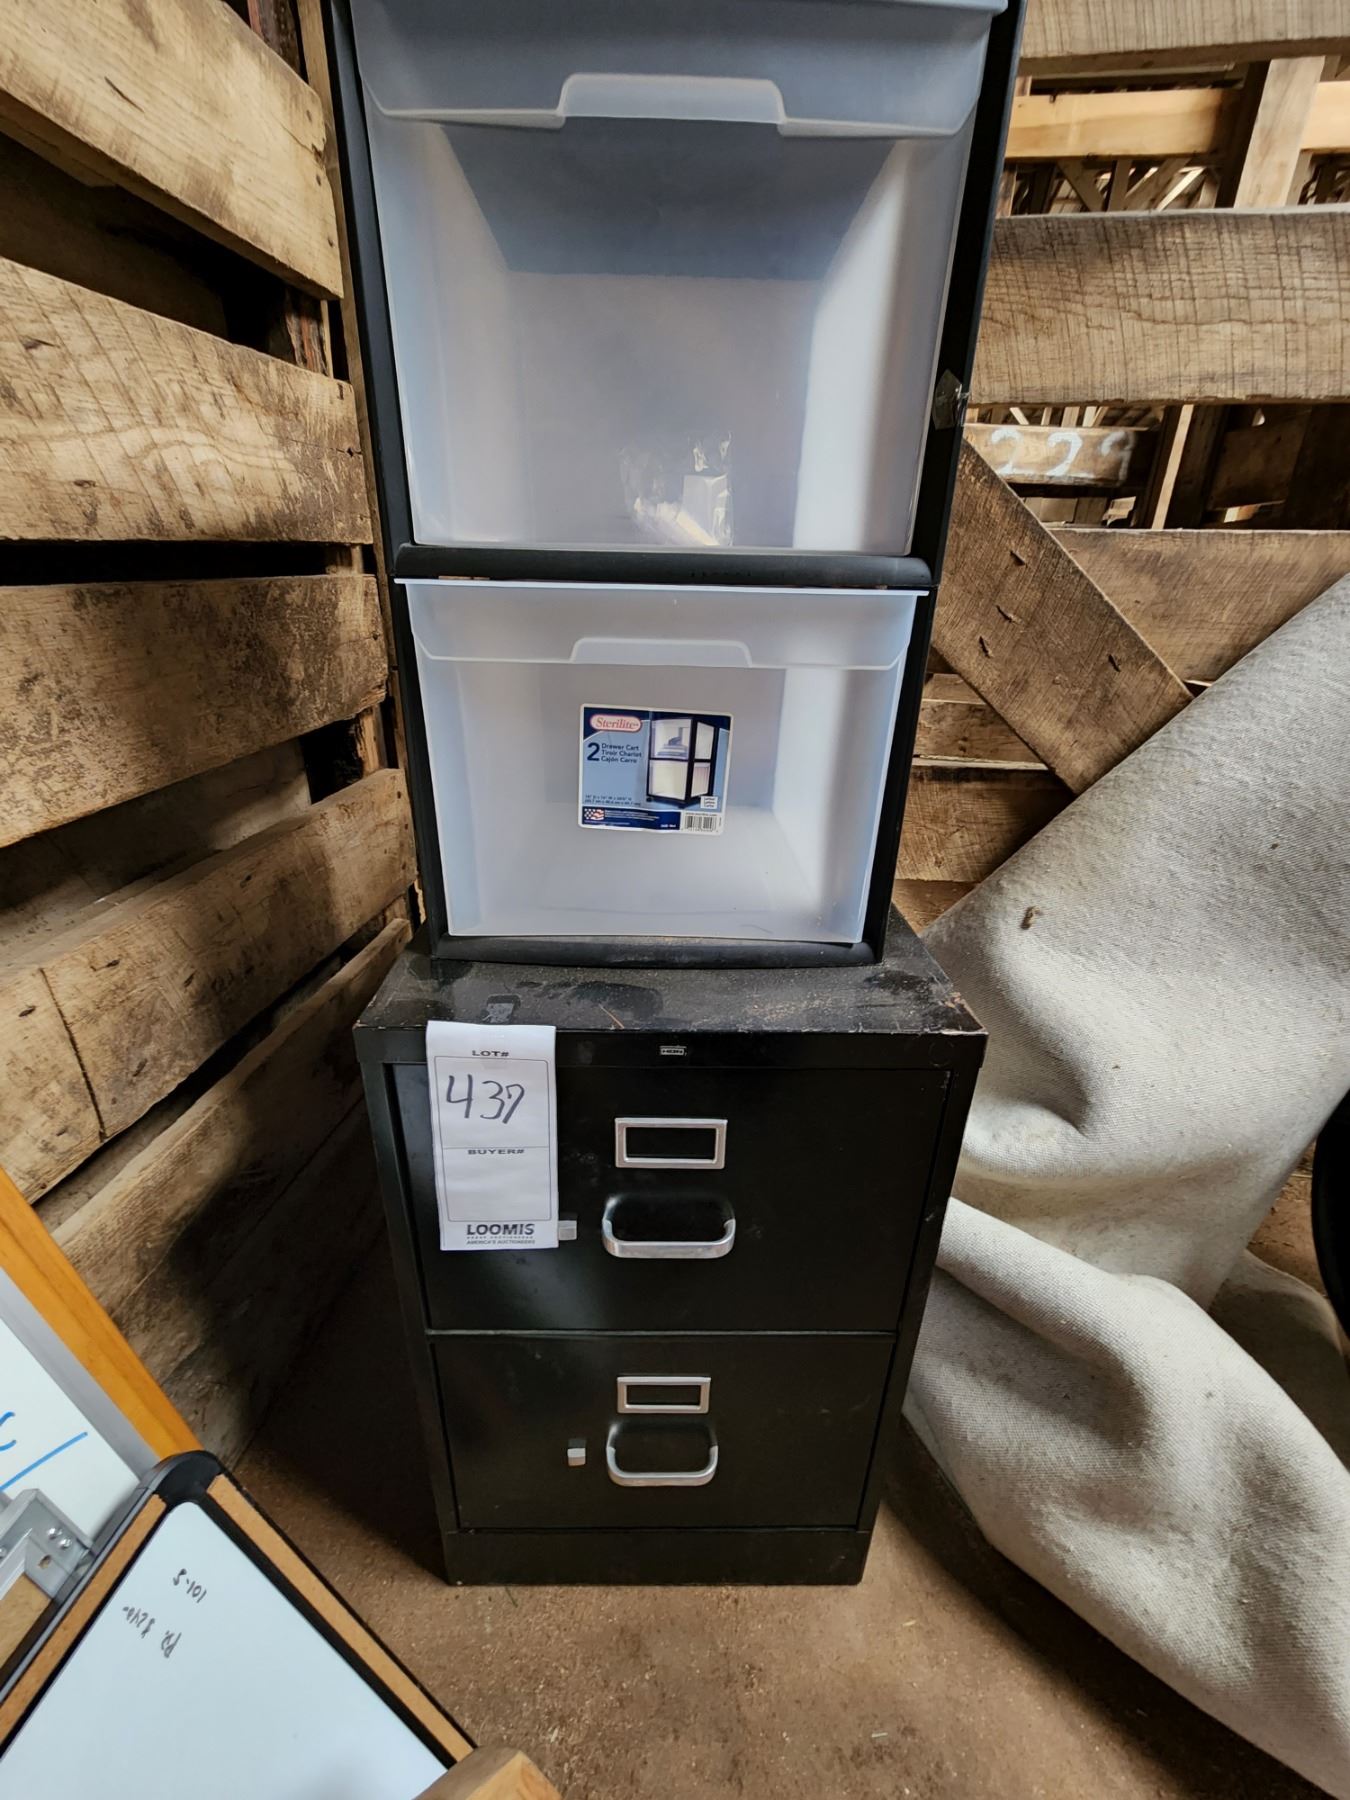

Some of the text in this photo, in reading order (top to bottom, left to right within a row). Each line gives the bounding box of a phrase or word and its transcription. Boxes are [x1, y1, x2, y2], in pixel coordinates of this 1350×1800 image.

[586, 742, 600, 762] 2
[601, 743, 625, 751] Drawer
[446, 1073, 525, 1125] 437
[466, 1223, 535, 1236] LOOMIS
